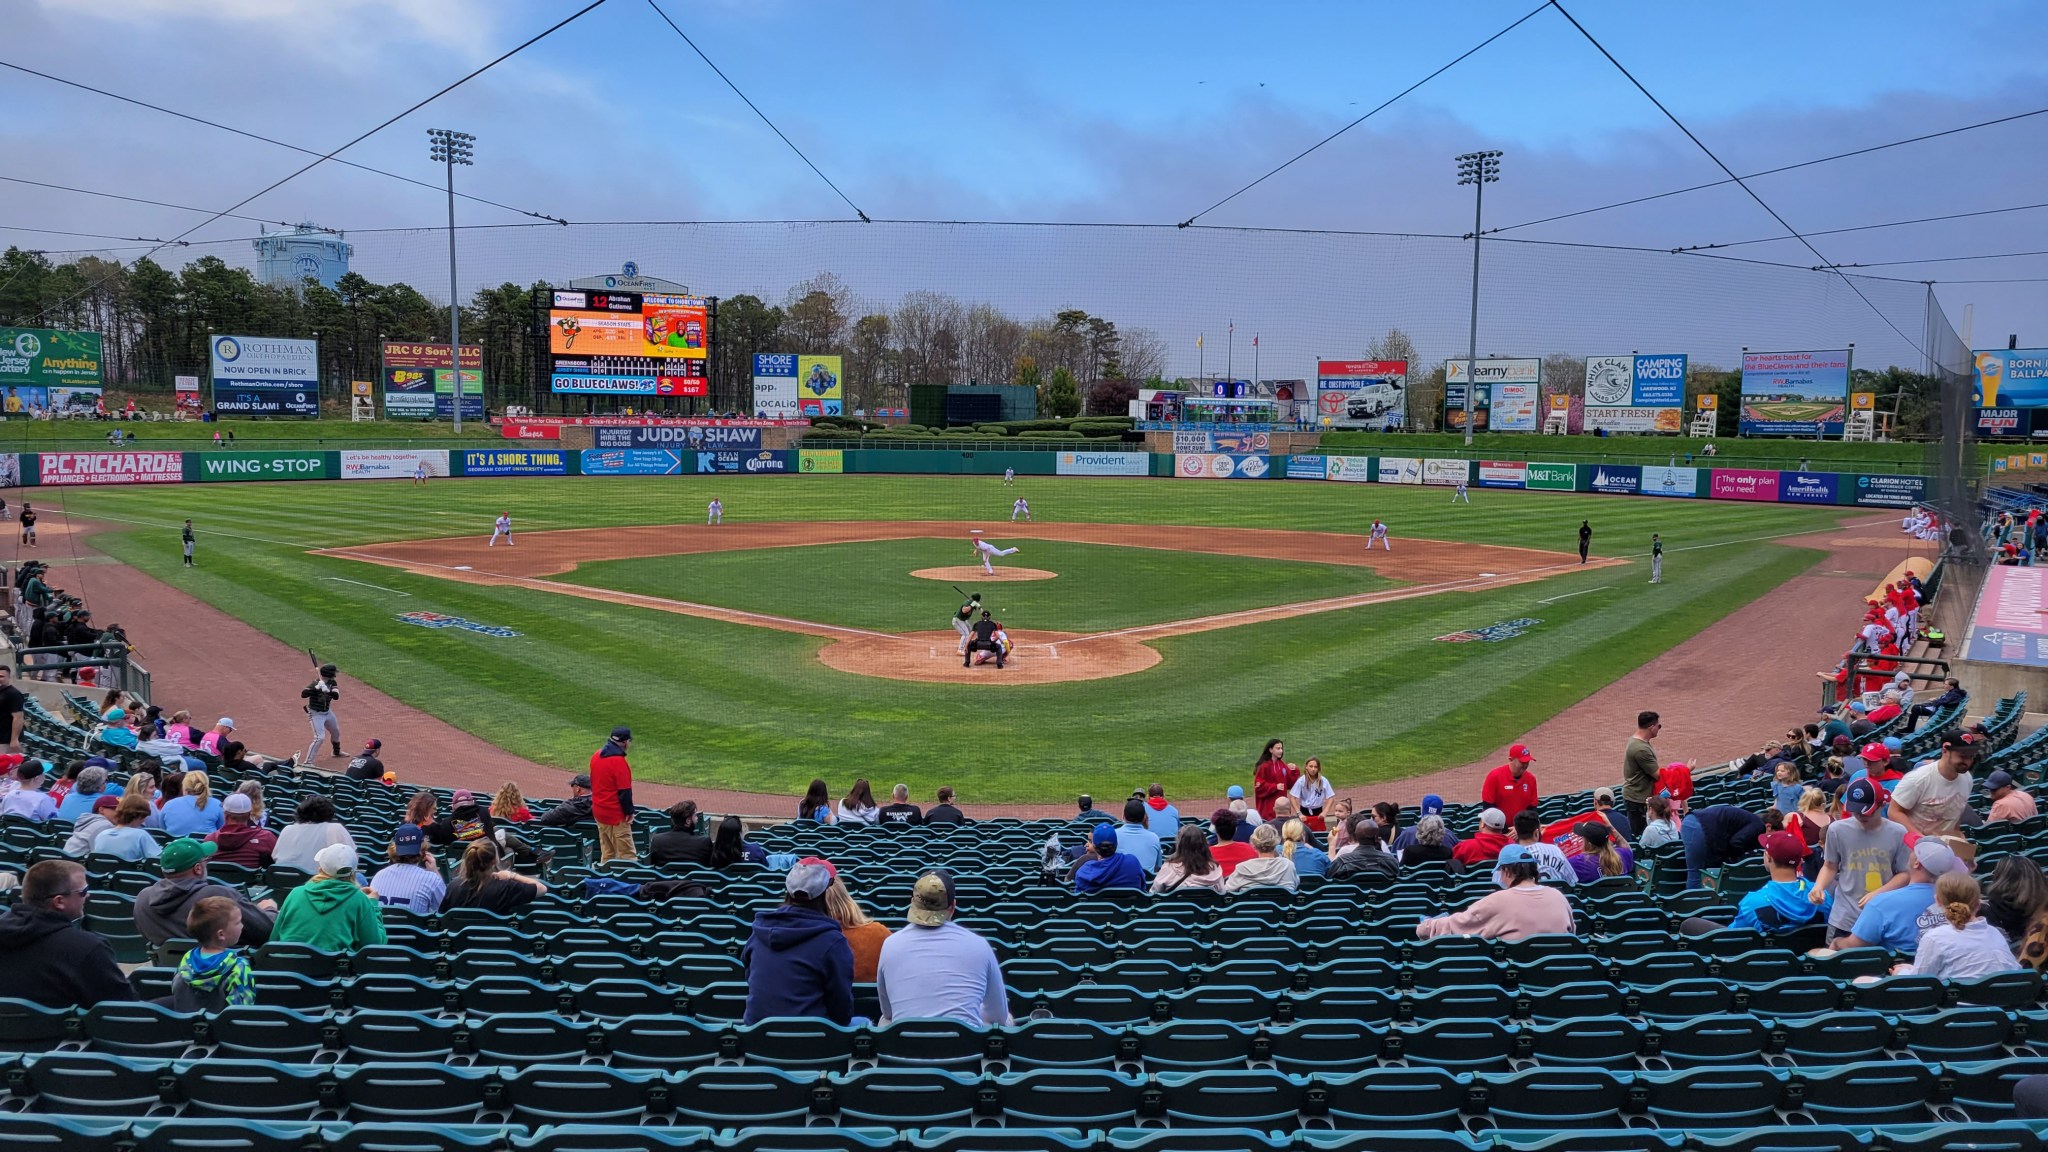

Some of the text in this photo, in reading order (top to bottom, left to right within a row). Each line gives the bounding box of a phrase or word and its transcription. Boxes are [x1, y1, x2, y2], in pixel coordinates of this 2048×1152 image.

[593, 296, 607, 307] 12
[223, 344, 233, 353] R
[242, 343, 313, 354] ROTHMAN
[385, 346, 410, 354] JRC
[412, 346, 422, 354] &
[458, 348, 480, 356] LLC
[42, 357, 97, 370] Anything
[758, 354, 792, 364] SHORE
[1637, 359, 1682, 368] CAMPING
[2010, 360, 2040, 368] BORN
[1605, 359, 1628, 372] CLAW
[1587, 361, 1603, 388] WHITE
[1637, 368, 1682, 379] WORLD
[555, 379, 639, 390] GO BLUECLAWS!
[755, 384, 777, 392] app.
[1586, 410, 1655, 418] START FRESH
[637, 428, 757, 442] JUDD SHAW
[168, 454, 174, 462] &
[467, 453, 563, 465] IT'S A SHORE THING.
[1076, 455, 1125, 465] Provident
[74, 454, 167, 474] RICHARD
[167, 462, 182, 472] SON
[206, 458, 321, 473] WING STOP
[746, 457, 783, 472] Corona
[42, 472, 182, 484] APPLIANCES ELECTRONICS MATTRESSES
[1528, 470, 1574, 481] M&T Bank
[1737, 475, 1756, 485] only
[1759, 477, 1775, 486] plan
[1736, 485, 1756, 493] need.
